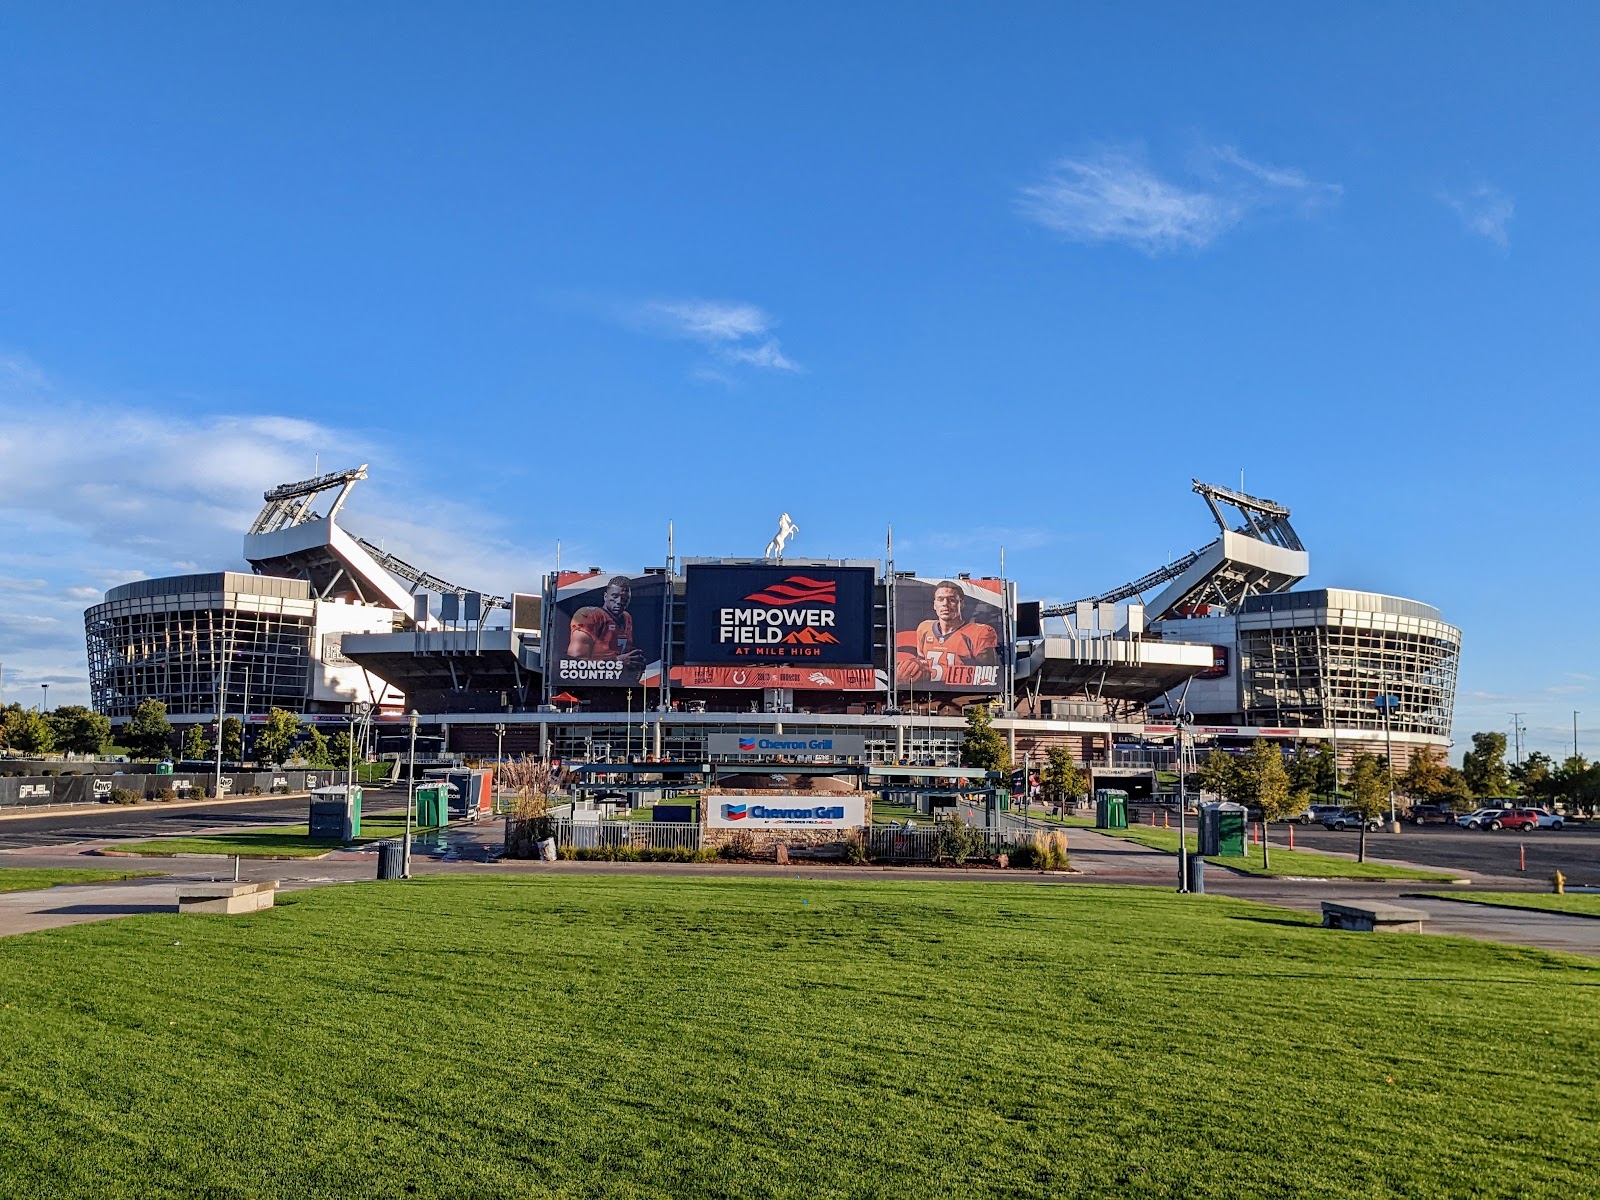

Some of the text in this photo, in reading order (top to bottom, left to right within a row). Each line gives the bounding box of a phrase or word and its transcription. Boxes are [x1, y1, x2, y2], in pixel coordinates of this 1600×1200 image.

[720, 608, 836, 627] EMPOWER
[719, 626, 783, 644] FIELD
[617, 638, 628, 655] 7
[735, 647, 821, 656] AT MILE HIGH
[559, 660, 624, 670] BRONCOS
[559, 670, 622, 680] COUNTRY
[947, 666, 974, 684] LET'S
[758, 738, 833, 750] Chevron Grill
[751, 805, 845, 819] Chevron Grill
